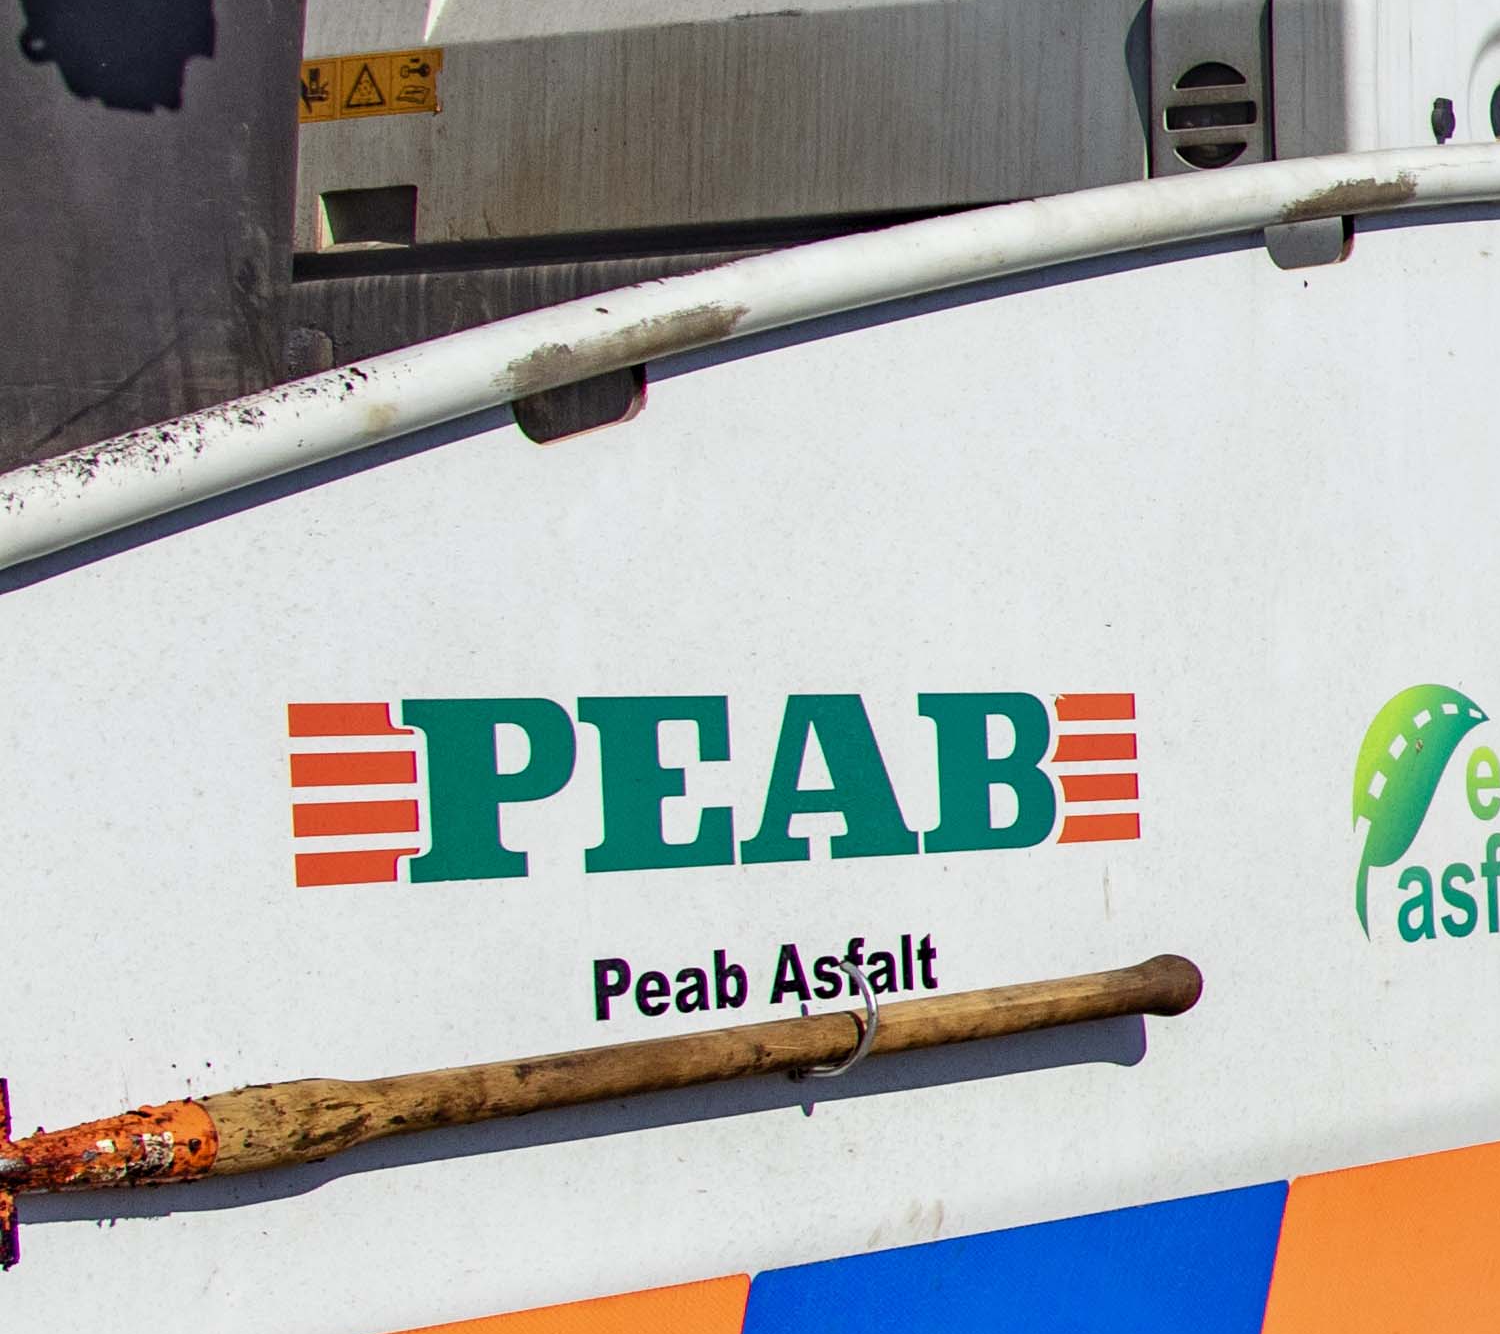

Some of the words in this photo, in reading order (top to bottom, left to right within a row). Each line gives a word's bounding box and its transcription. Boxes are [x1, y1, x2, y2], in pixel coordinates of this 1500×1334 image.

[402, 691, 1059, 883] PEAB
[593, 948, 748, 1021] Peab
[769, 933, 939, 1005] Asfalt
